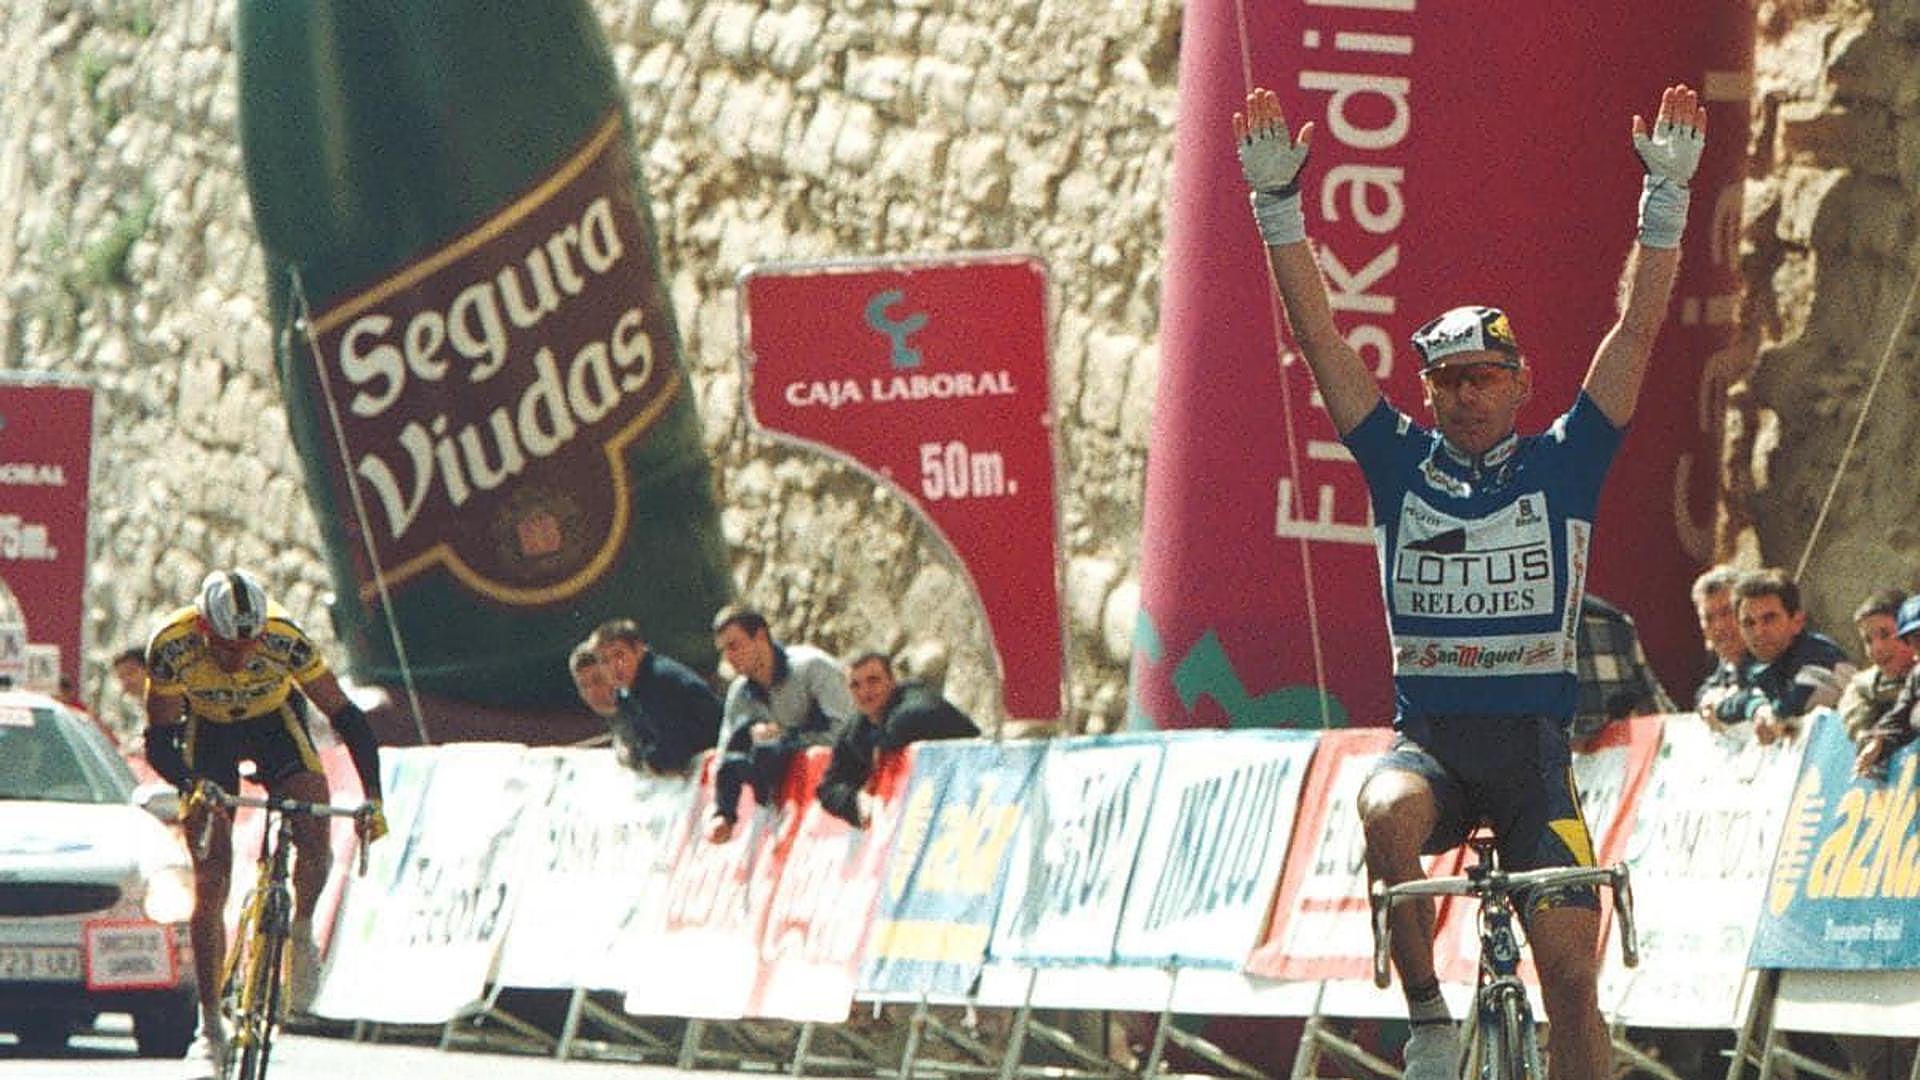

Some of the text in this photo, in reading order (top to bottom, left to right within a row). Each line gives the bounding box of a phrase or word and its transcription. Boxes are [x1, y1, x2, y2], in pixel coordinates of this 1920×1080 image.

[340, 197, 624, 418] Segura
[785, 370, 1016, 409] CAJA LABORAL
[358, 307, 655, 538] Viudas
[919, 439, 1019, 501] 50m.
[1396, 548, 1550, 587] LOTUS
[1411, 587, 1535, 615] RELOJES
